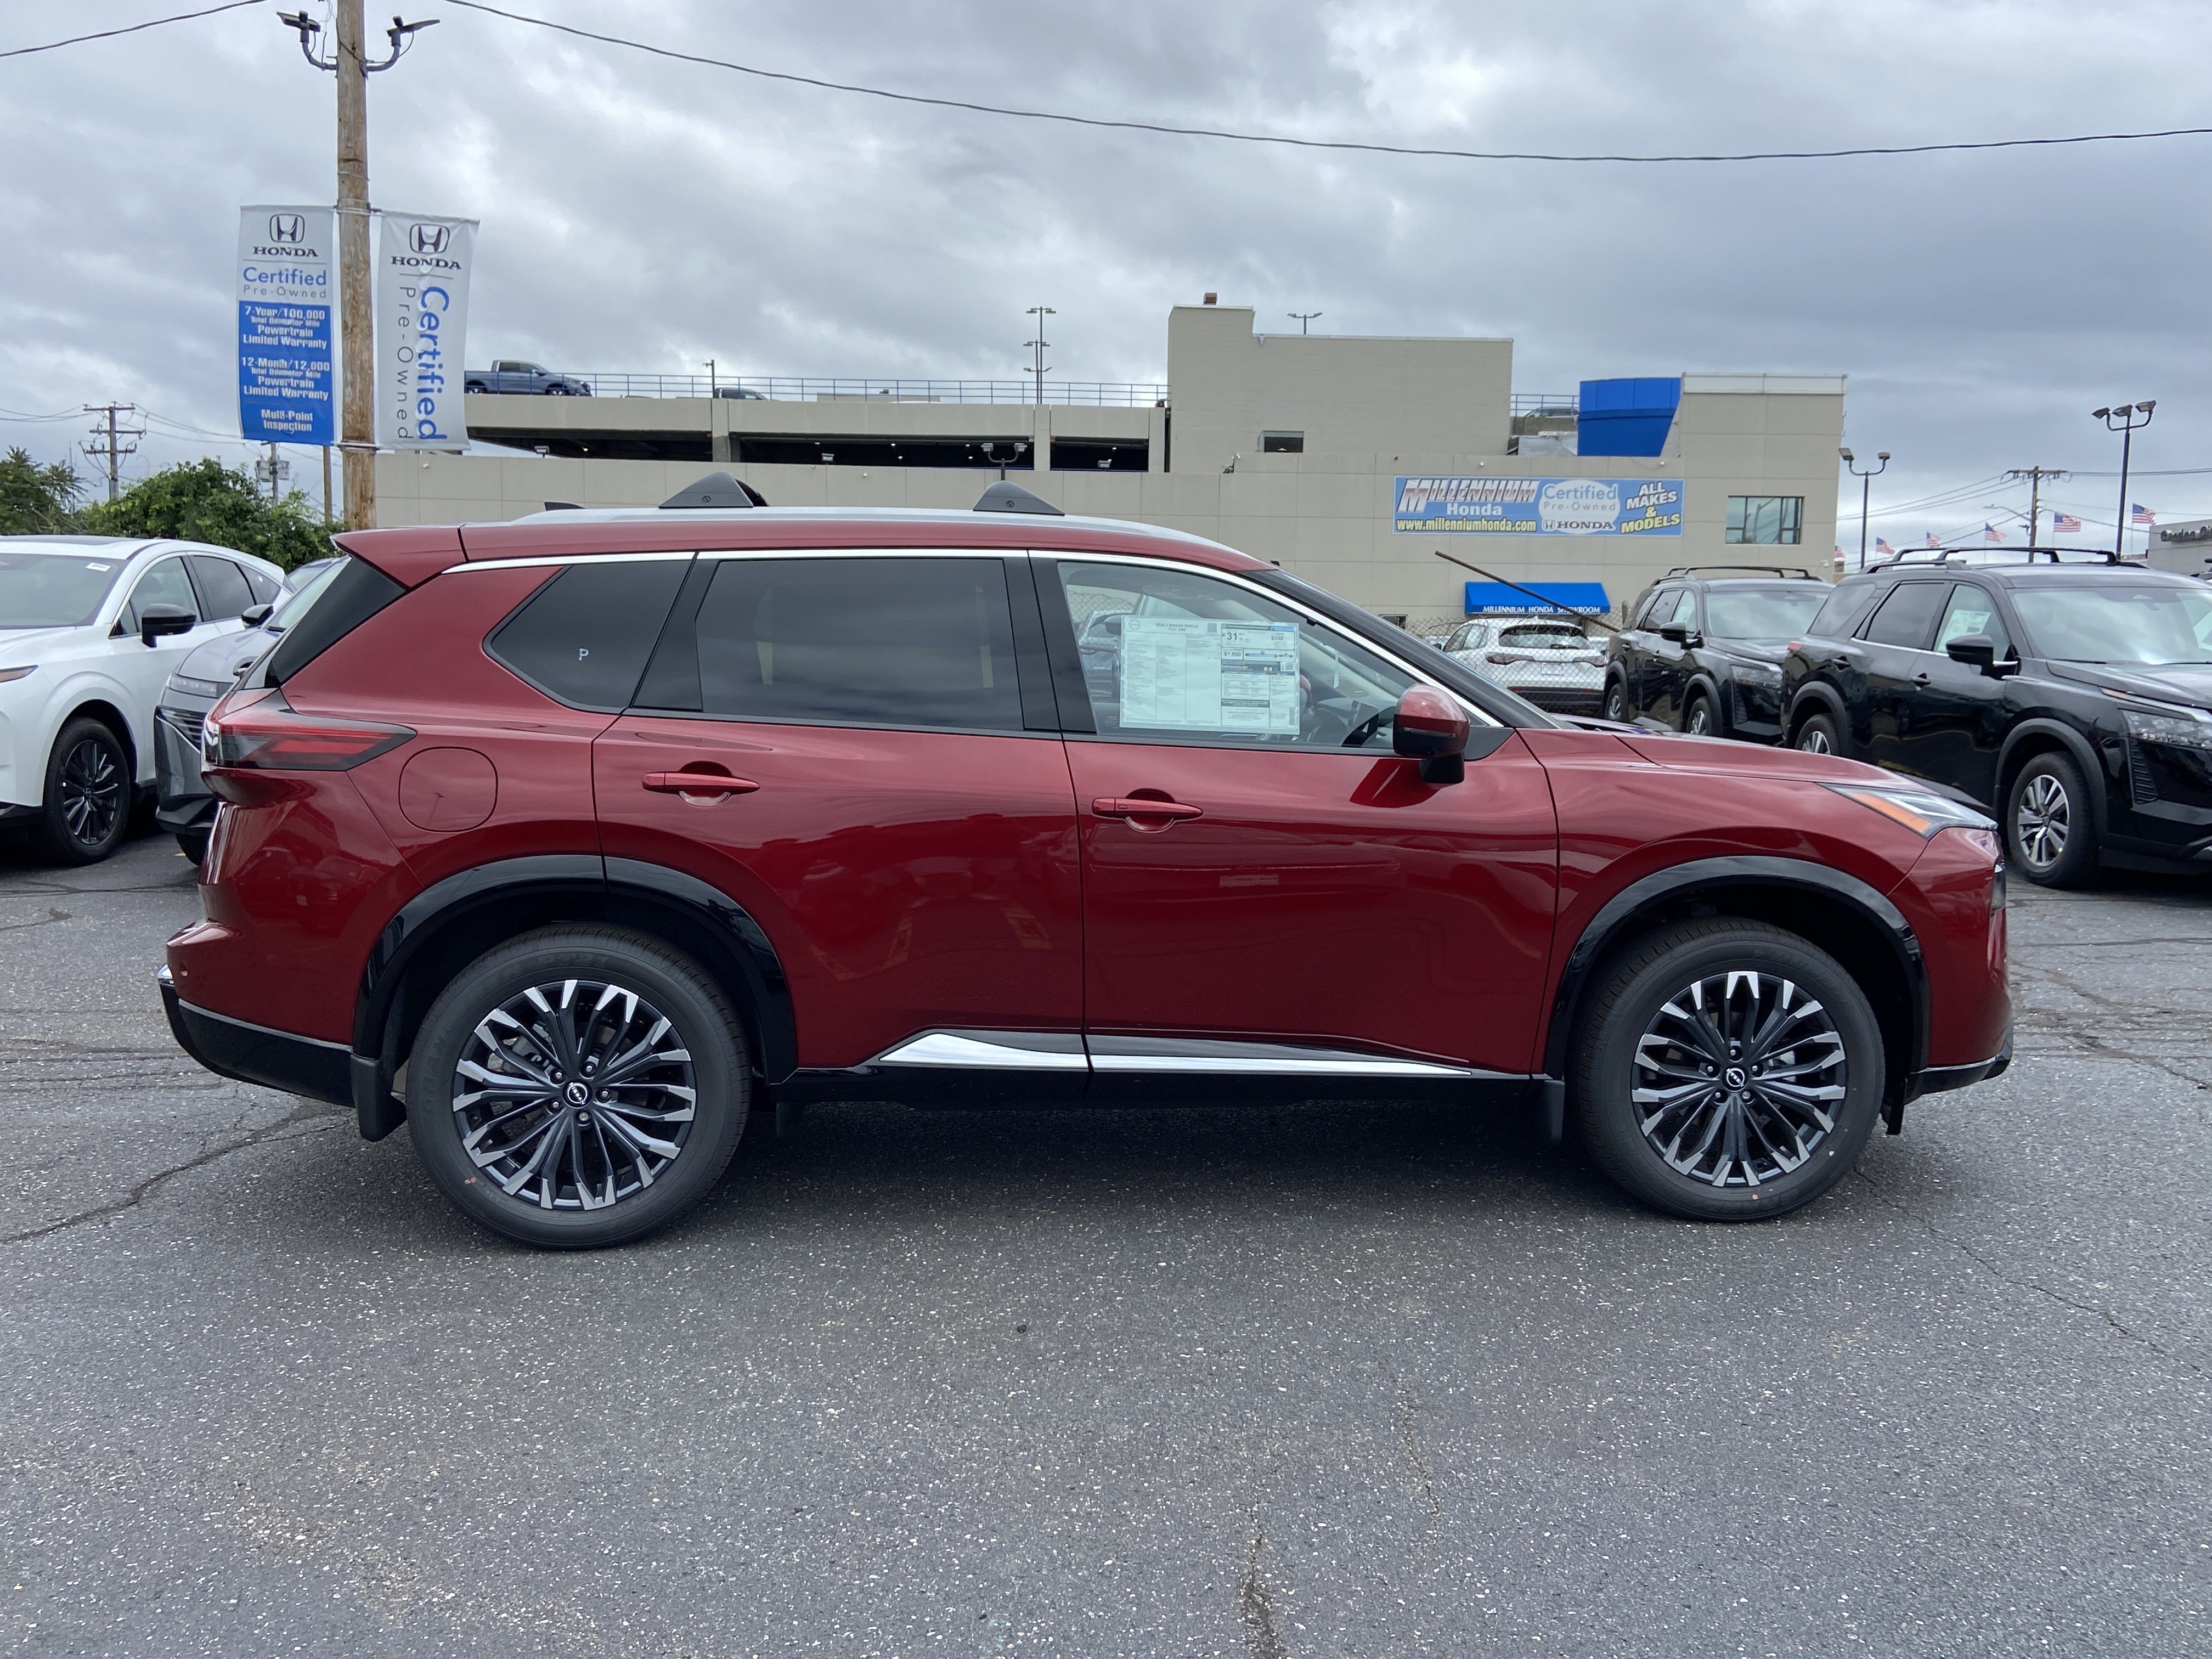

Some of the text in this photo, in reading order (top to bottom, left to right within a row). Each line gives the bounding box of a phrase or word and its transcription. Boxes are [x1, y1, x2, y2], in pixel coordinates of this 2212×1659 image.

[253, 246, 319, 257] HONDA
[391, 255, 462, 270] HONDA
[243, 267, 326, 286] Certified
[244, 284, 326, 298] Pre-Owned
[251, 315, 267, 324] Total
[258, 325, 313, 337] Powertrain
[243, 334, 328, 350] Limited Warranty
[241, 357, 330, 372] 12-Month/12,000
[397, 286, 416, 439] Pre-Owned
[417, 286, 450, 439] Certified
[258, 376, 314, 389] Powertrain
[244, 385, 329, 401] Limited Warranty
[261, 409, 313, 422] Multi-Point
[263, 420, 312, 432] Inspection
[1396, 478, 1541, 514] MILLENNIUM
[1543, 485, 1617, 500] Certified
[1638, 481, 1666, 497] ALL
[1544, 501, 1616, 511] Pre-Owned
[1626, 491, 1678, 511] MAKES
[1446, 503, 1502, 516] Honda
[1645, 505, 1657, 518] &
[1396, 517, 1537, 532] www.millenniumhonda.com
[1556, 521, 1614, 529] HONDA
[1620, 513, 1681, 534] MODELS
[1226, 632, 1237, 641] 31
[579, 648, 589, 661] P
[569, 1082, 586, 1105] NISSAN
